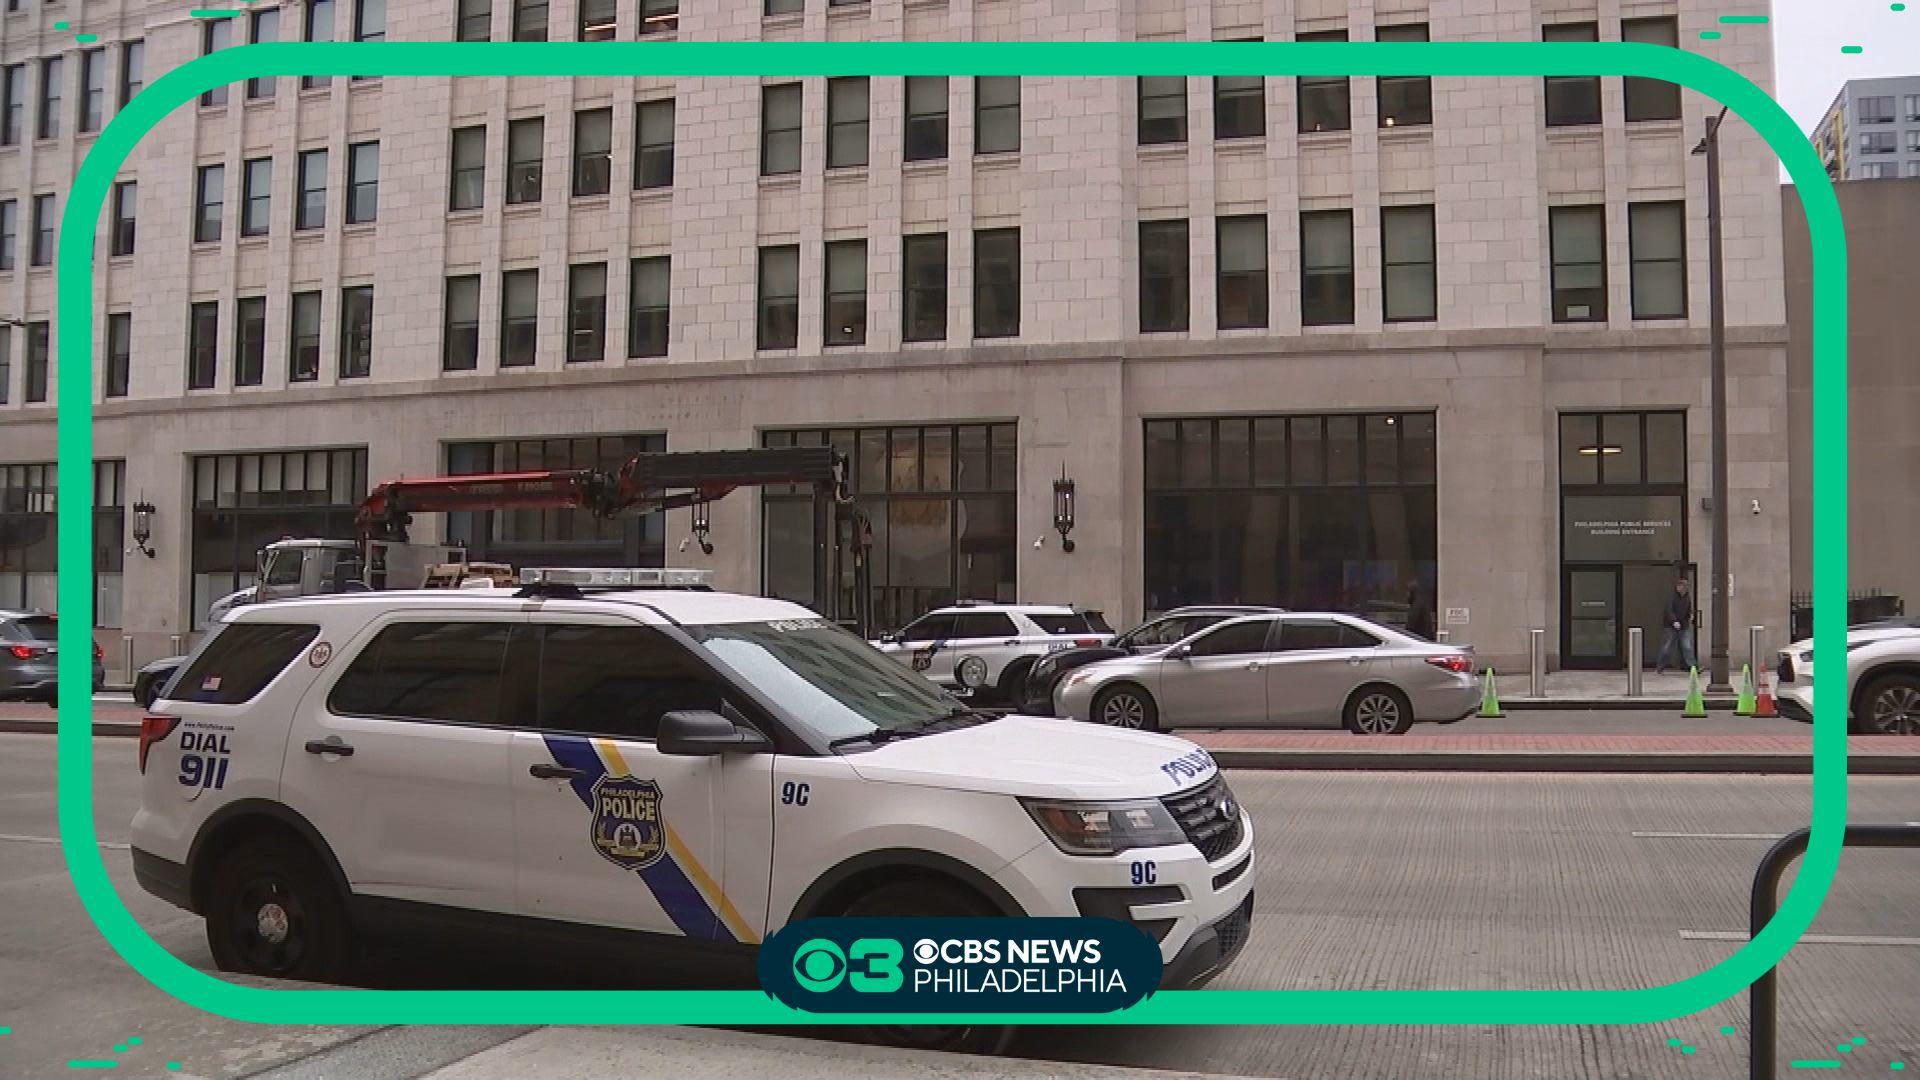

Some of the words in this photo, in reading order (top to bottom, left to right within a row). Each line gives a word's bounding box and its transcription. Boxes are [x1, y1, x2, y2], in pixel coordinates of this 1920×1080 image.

[180, 731, 231, 754] DIAL
[178, 755, 230, 790] 911
[601, 787, 656, 799] PHILADELPHIA
[781, 781, 810, 807] 9C
[602, 797, 656, 821] POLICE
[1130, 861, 1157, 885] 9C
